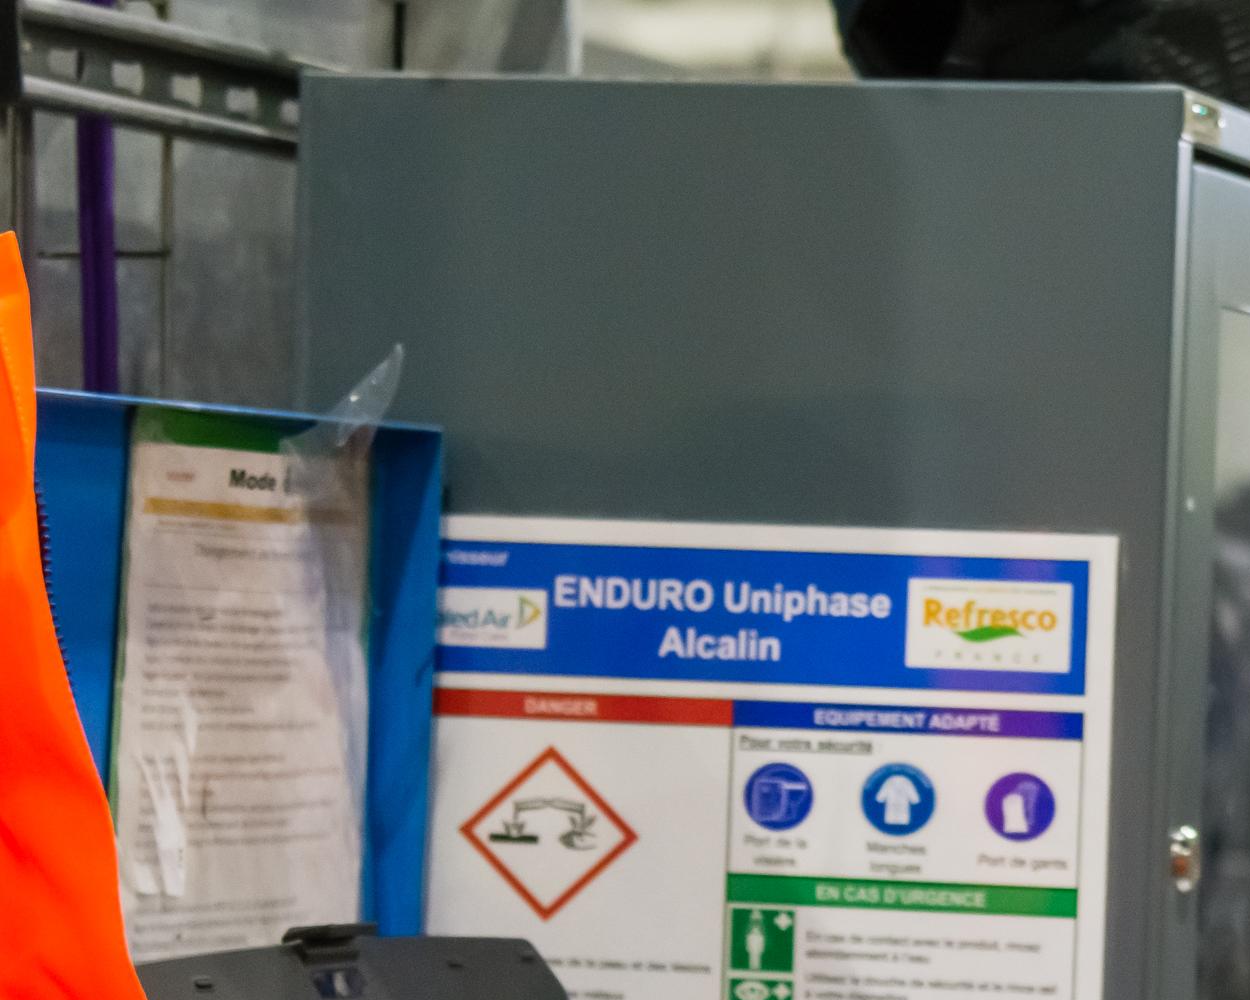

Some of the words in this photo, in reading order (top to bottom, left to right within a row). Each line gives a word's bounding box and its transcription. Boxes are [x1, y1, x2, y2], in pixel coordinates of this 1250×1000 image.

[228, 468, 277, 492] Mode
[554, 574, 714, 612] ENDURO
[723, 580, 892, 623] Uniphase
[922, 596, 1058, 632] Refresco
[657, 626, 782, 662] Alcalin
[523, 695, 598, 715] DANGER
[813, 708, 926, 730] EQUIPEMENT
[866, 841, 927, 856] Manches
[815, 884, 841, 902] EN
[843, 886, 880, 904] CAS
[884, 888, 986, 908] D'URGENCE
